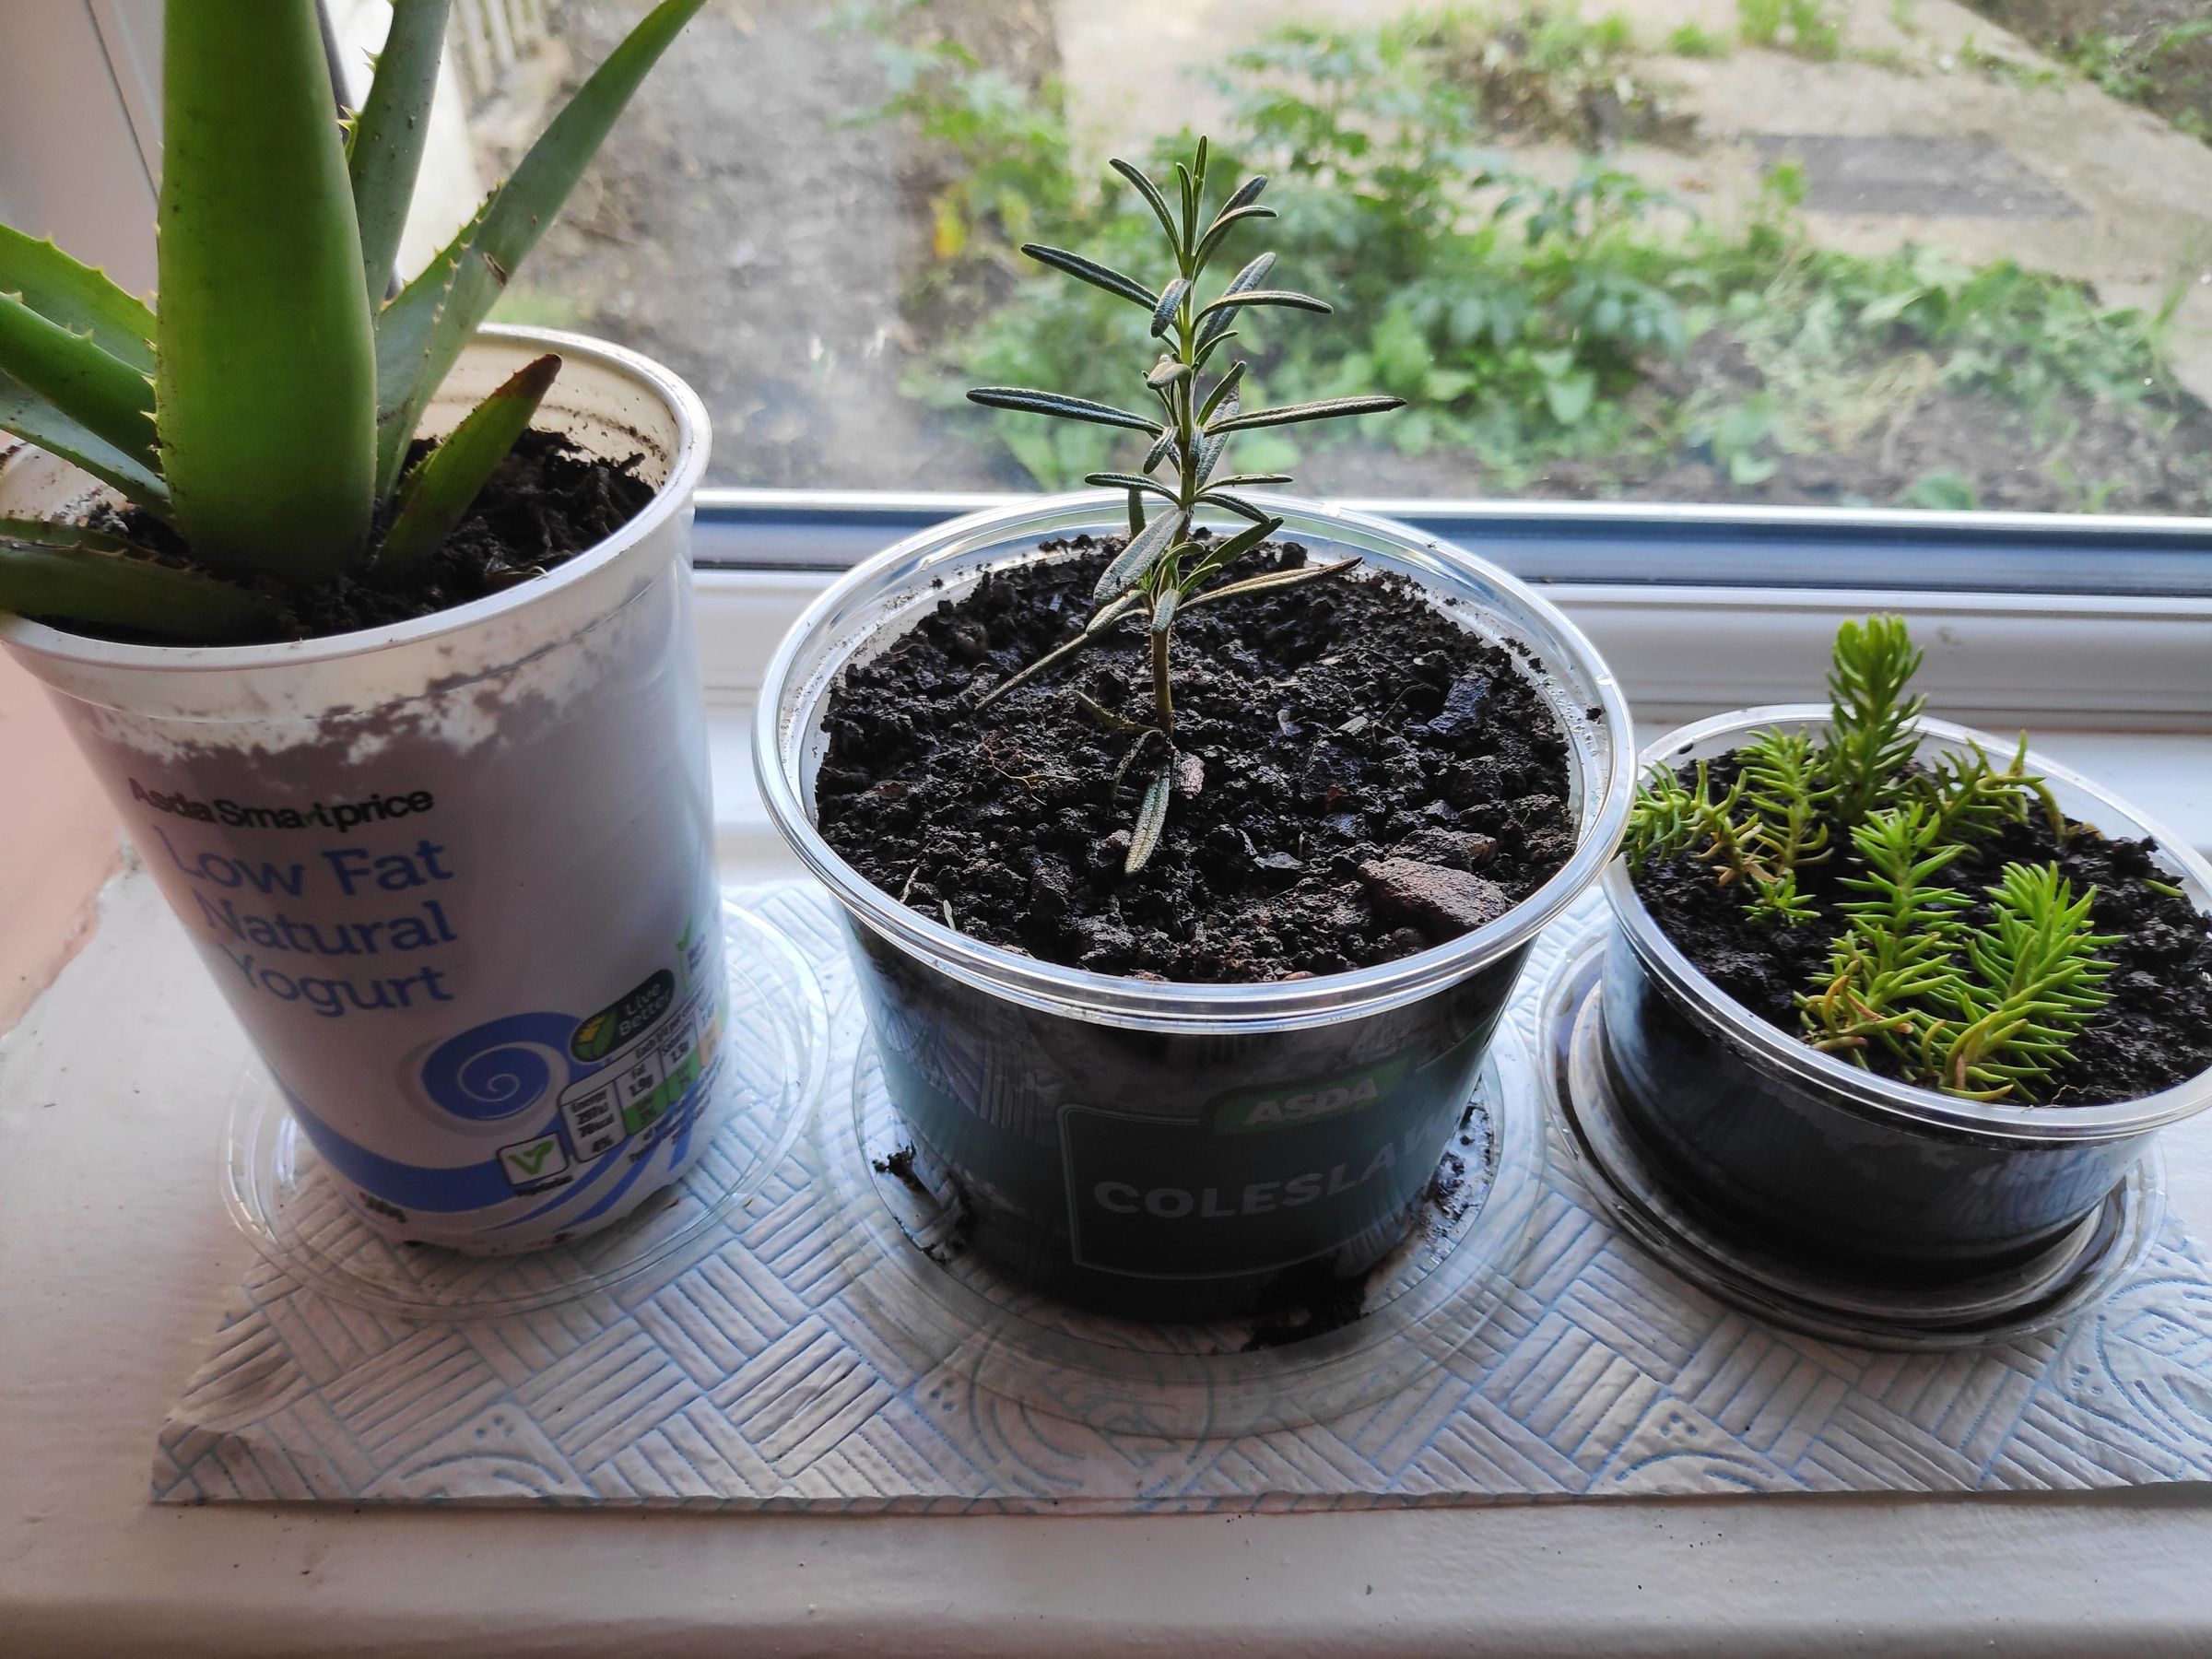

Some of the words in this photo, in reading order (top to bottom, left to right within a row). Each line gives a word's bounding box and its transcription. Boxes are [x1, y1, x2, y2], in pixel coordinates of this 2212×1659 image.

[127, 777, 218, 824] Asda
[213, 790, 434, 833] Smartprice
[152, 825, 303, 898] Low
[321, 839, 455, 896] Fat
[192, 888, 458, 955] Natural
[218, 943, 456, 1018] Yogurt
[625, 982, 661, 1016] Live
[618, 989, 671, 1036] Better
[1243, 1077, 1378, 1127] ASDA
